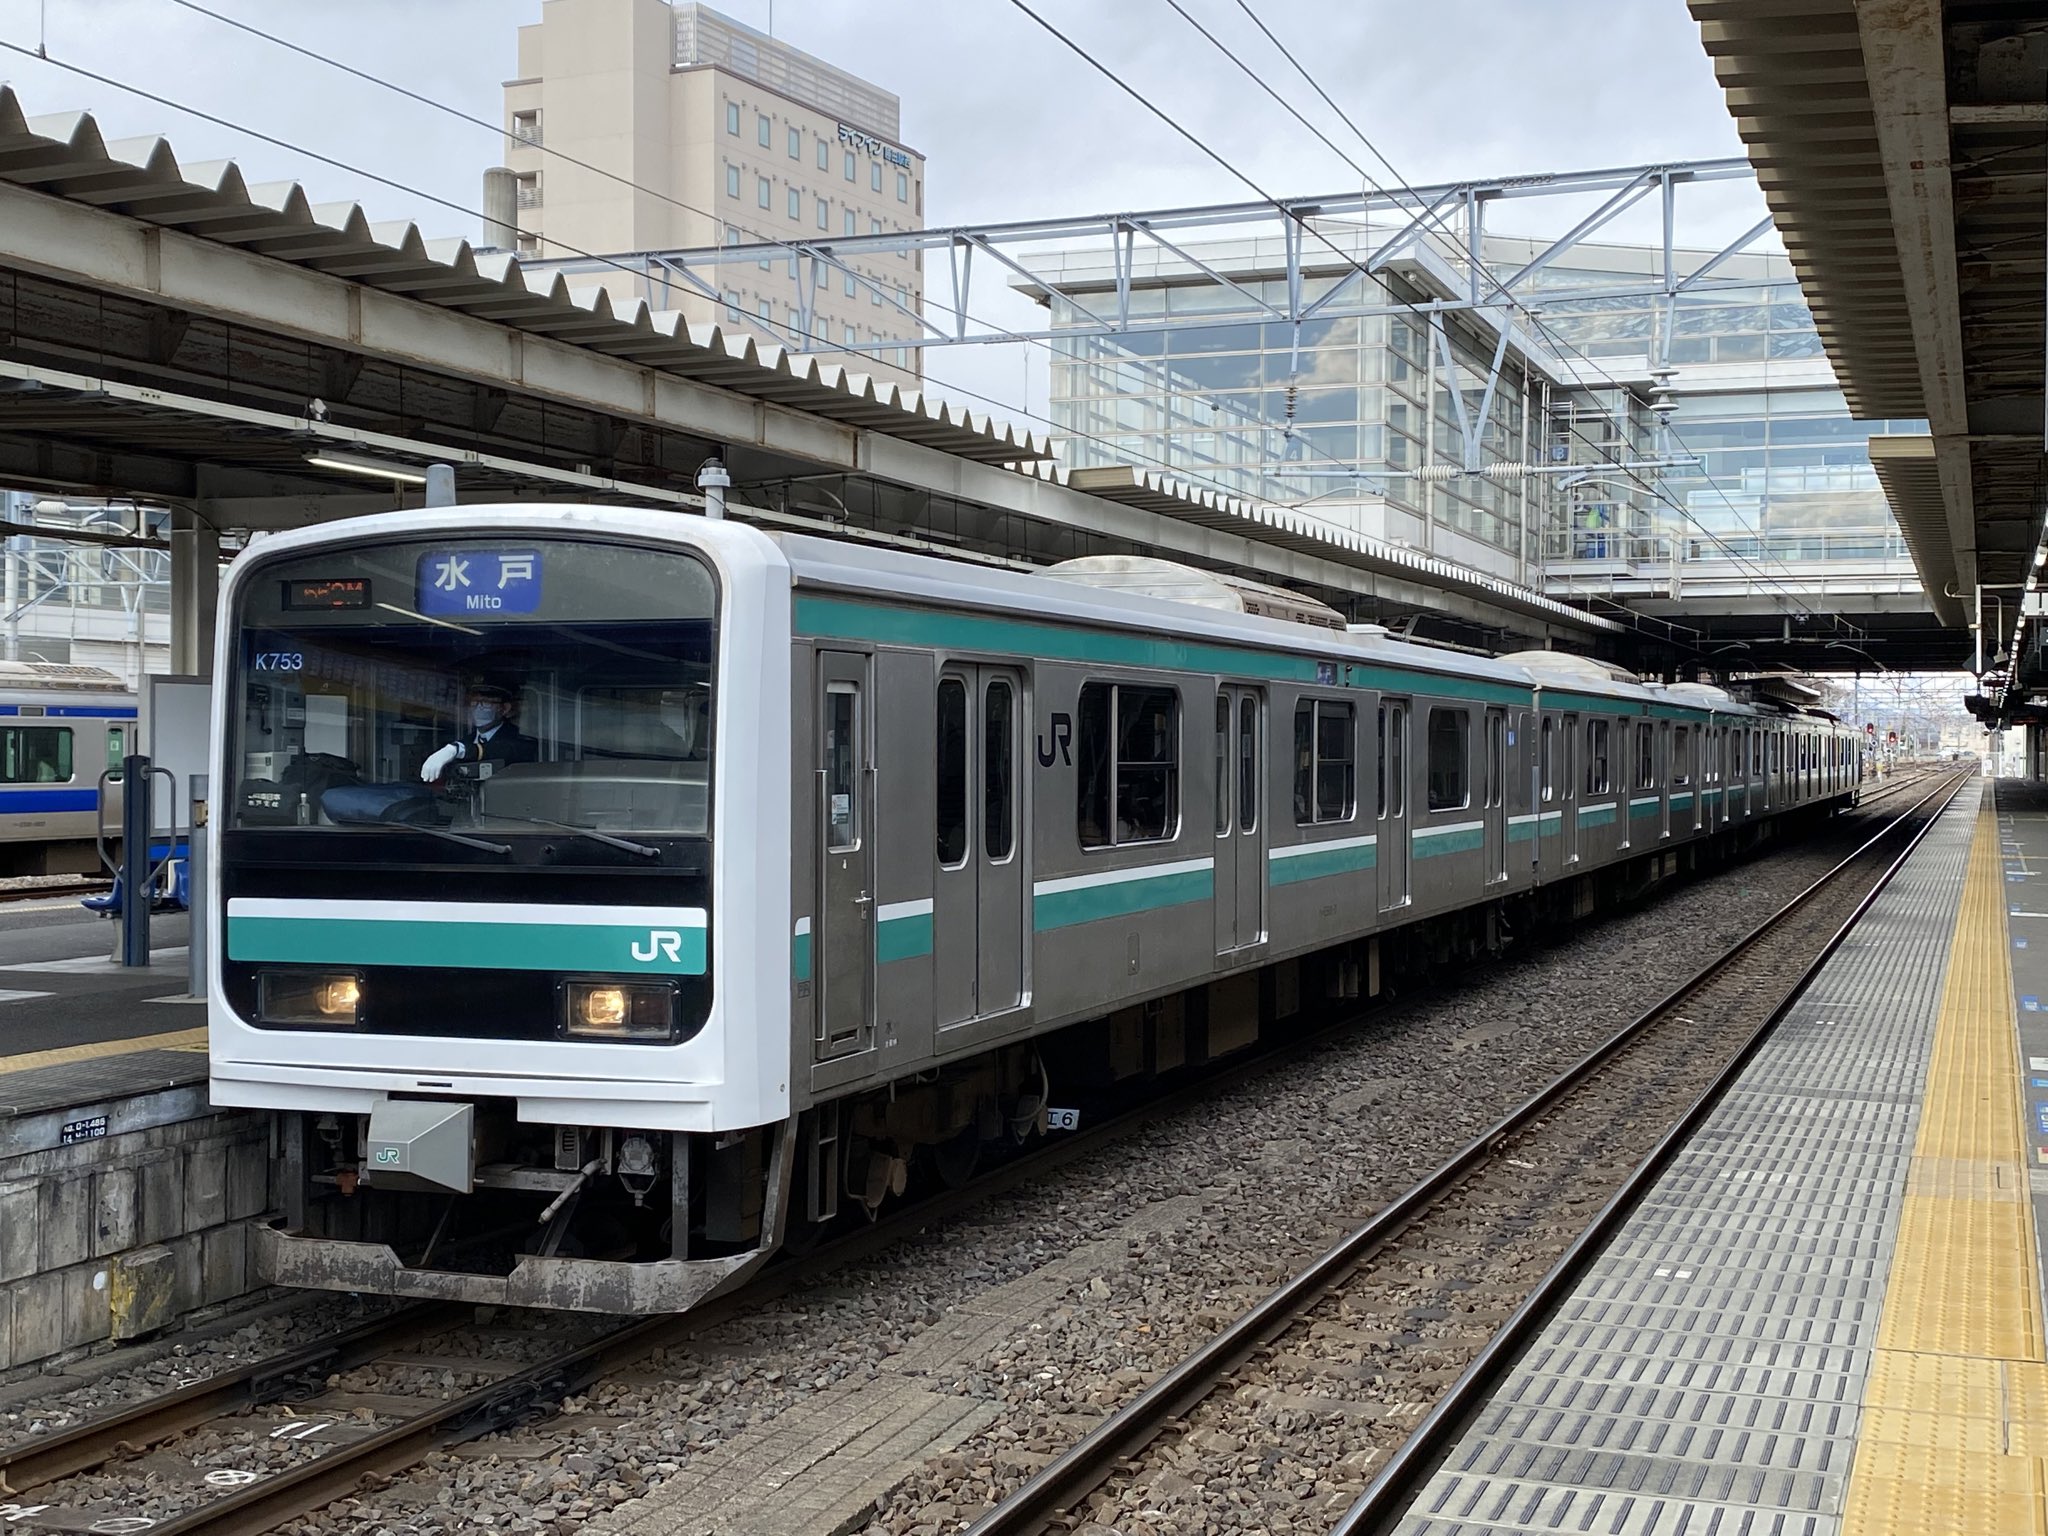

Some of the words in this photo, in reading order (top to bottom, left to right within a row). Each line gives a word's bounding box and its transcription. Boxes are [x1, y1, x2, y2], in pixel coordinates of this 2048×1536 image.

[838, 122, 881, 155] ライフイン
[434, 554, 534, 591] 水戸
[466, 594, 502, 610] Mito
[255, 652, 303, 671] K753
[1037, 712, 1072, 768] JR
[631, 930, 682, 963] JR
[376, 1147, 401, 1164] JR
